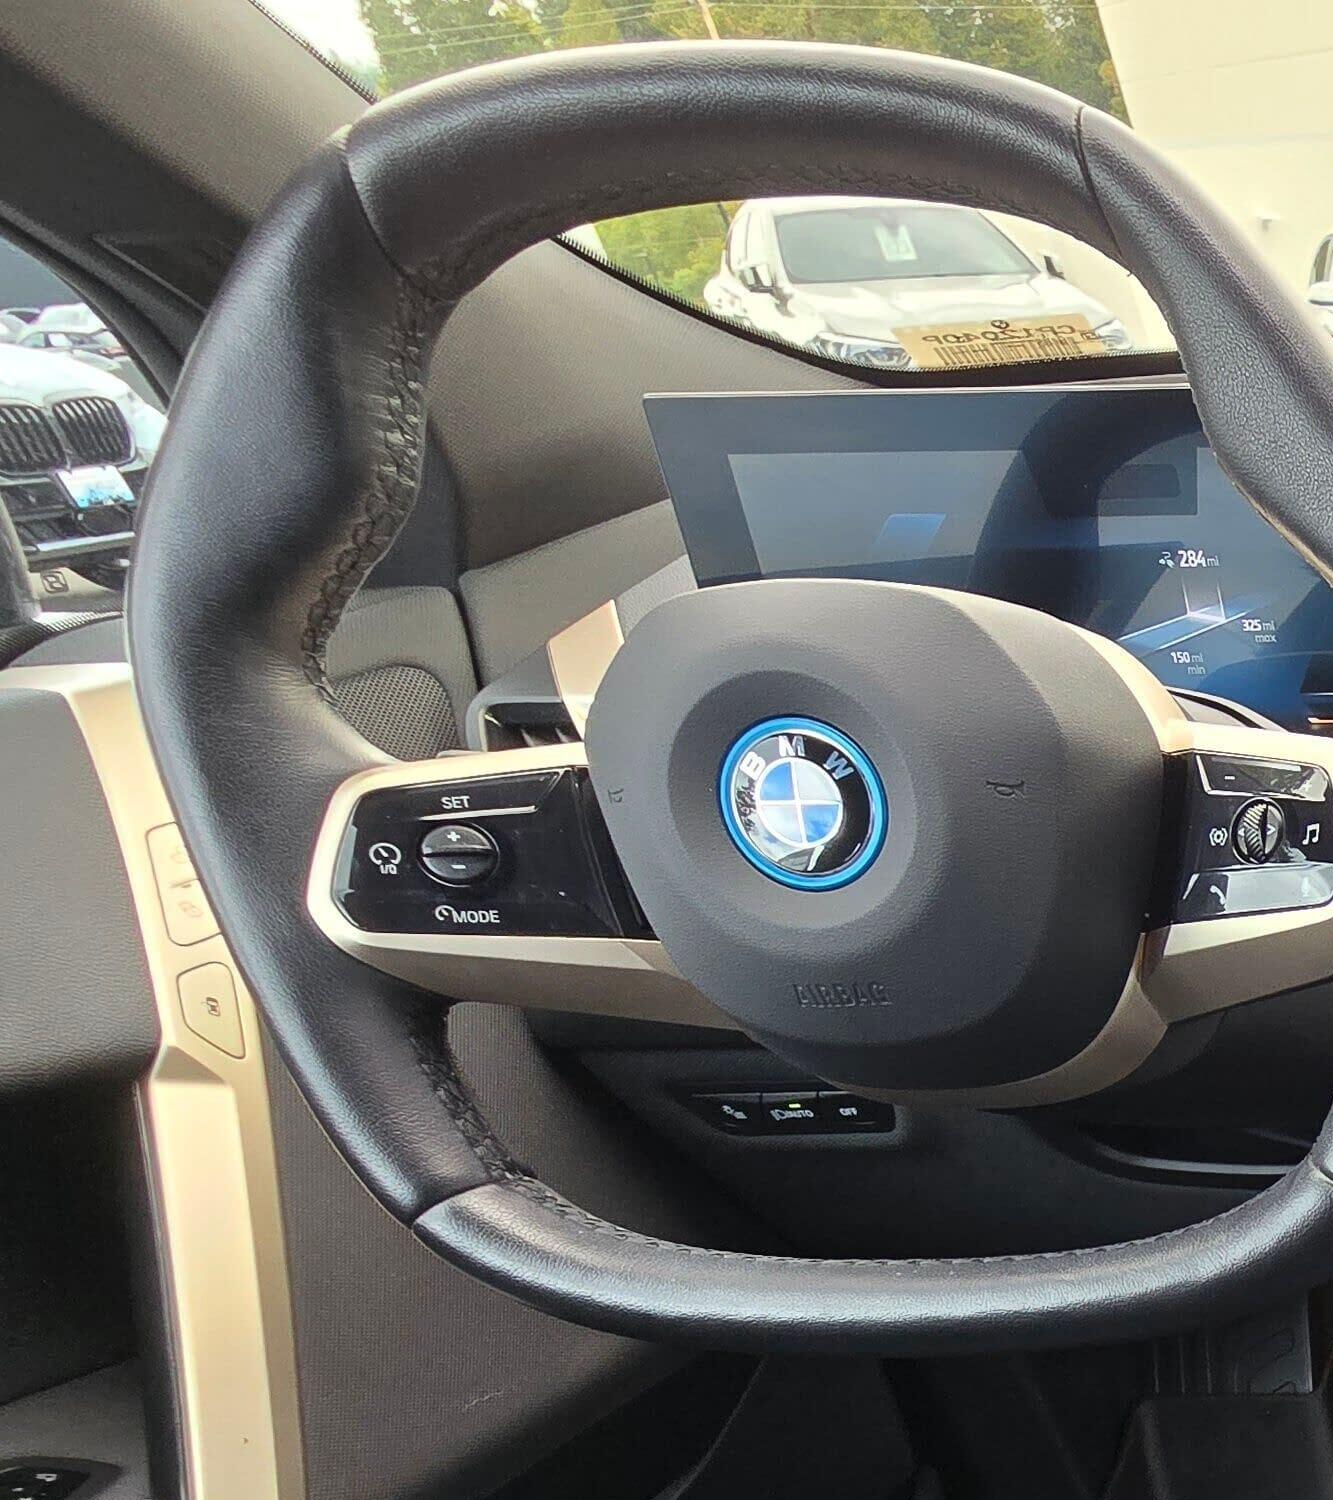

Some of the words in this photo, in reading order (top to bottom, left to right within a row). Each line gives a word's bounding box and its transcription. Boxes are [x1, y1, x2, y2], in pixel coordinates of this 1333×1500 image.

[1177, 549, 1207, 568] 284
[1241, 619, 1262, 632] 325
[1254, 633, 1277, 643] max
[1170, 651, 1191, 664] 150
[1187, 665, 1206, 676] min
[739, 735, 855, 781] BMW
[440, 795, 471, 810] SET
[452, 909, 500, 924] MODE
[791, 982, 893, 1010] AIRBAG
